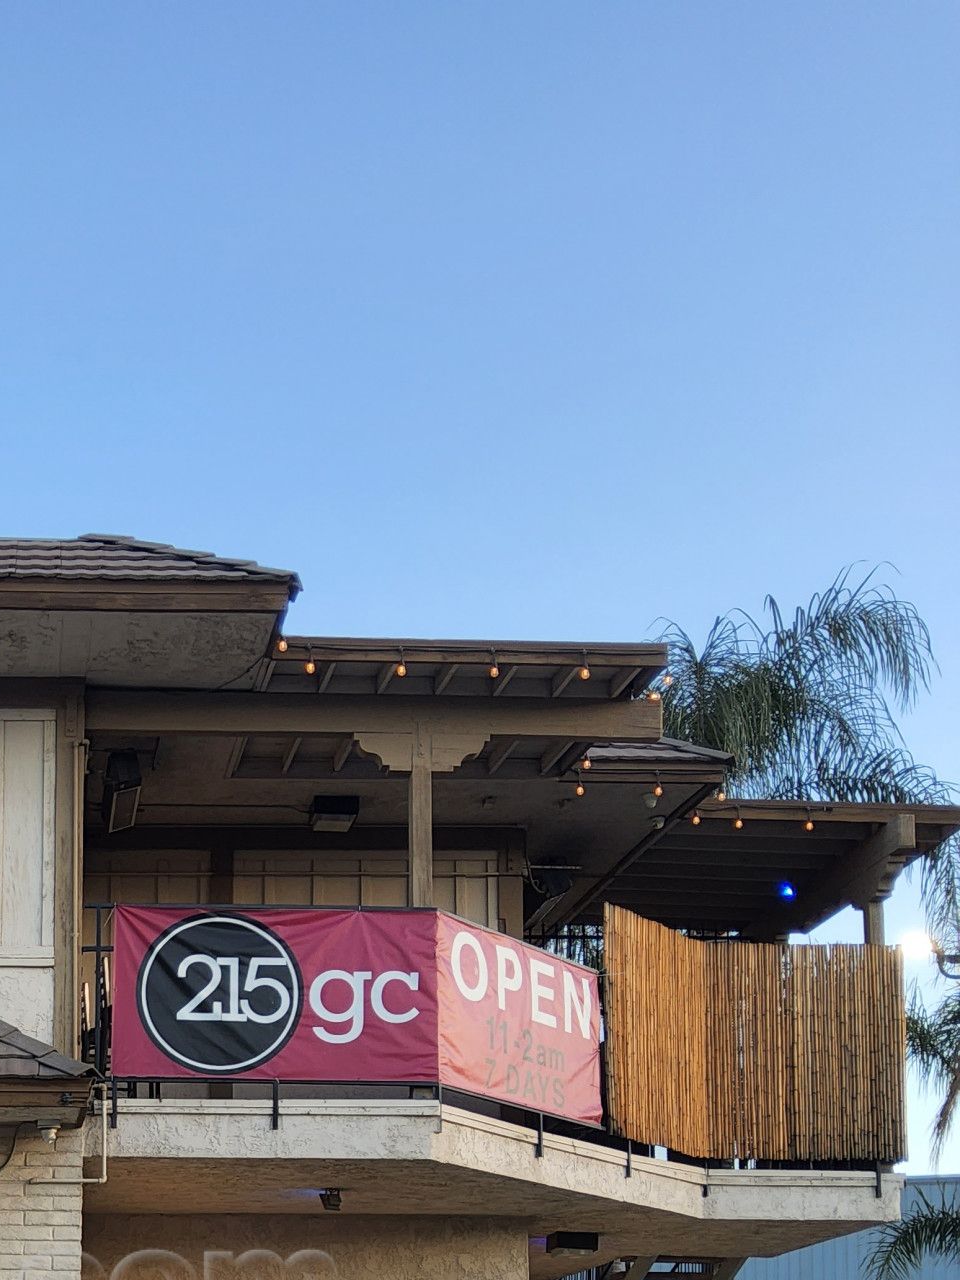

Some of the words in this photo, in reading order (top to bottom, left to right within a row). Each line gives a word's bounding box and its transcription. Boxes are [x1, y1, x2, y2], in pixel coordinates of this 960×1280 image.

[176, 953, 290, 1024] 215
[309, 969, 420, 1044] gc
[450, 931, 592, 1040] OPEN
[485, 1057, 497, 1090] 7
[506, 1063, 566, 1109] DAYS
